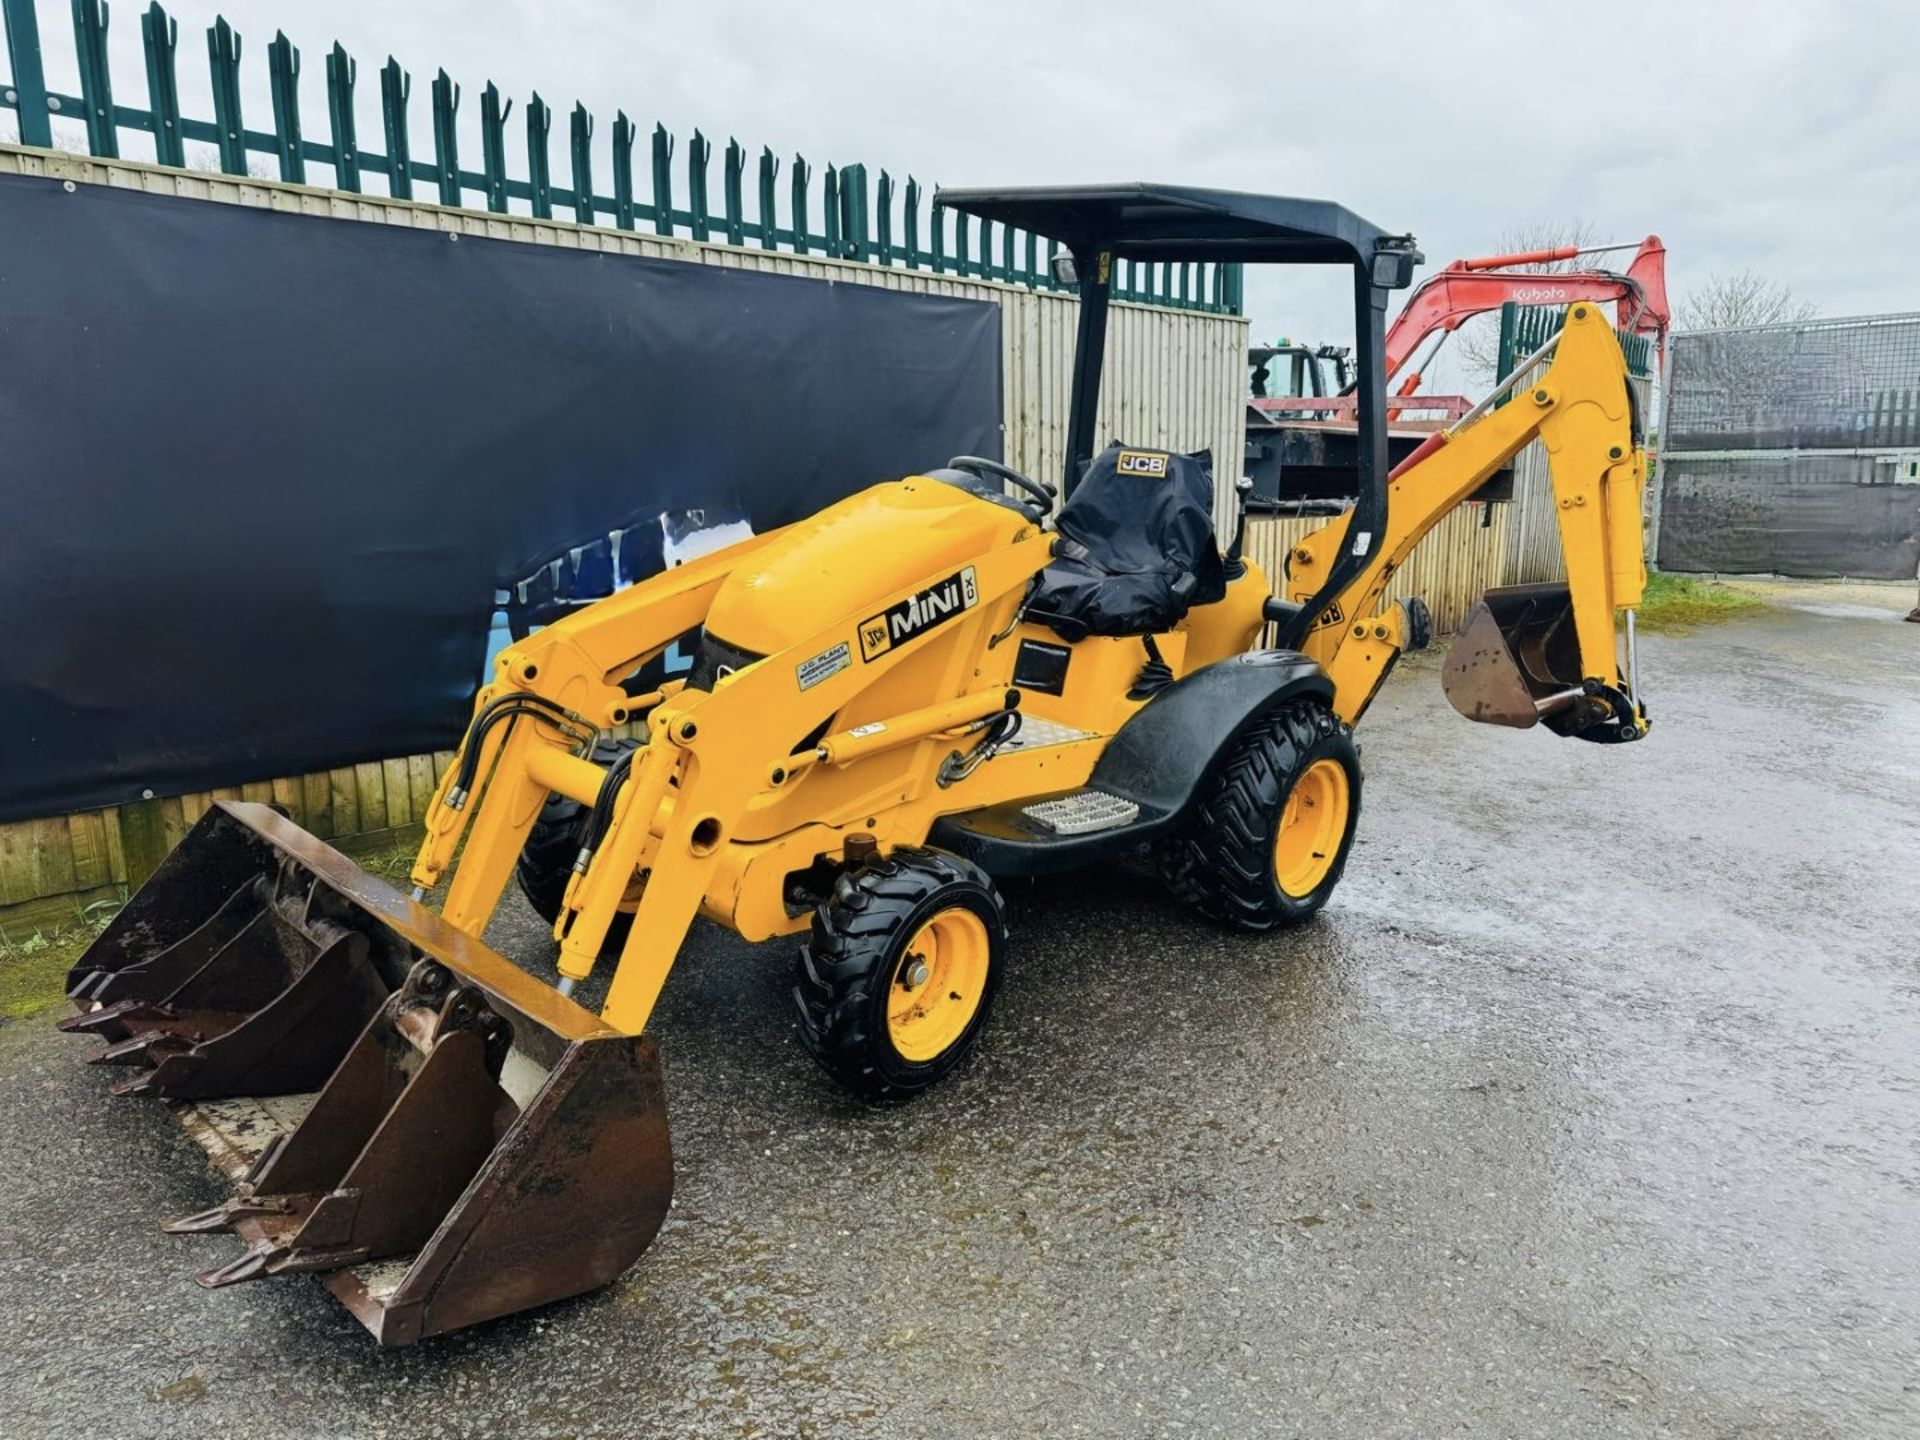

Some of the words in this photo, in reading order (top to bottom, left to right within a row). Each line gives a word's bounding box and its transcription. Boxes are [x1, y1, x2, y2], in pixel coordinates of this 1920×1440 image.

[1512, 286, 1566, 301] Kubota
[1122, 456, 1164, 472] JCB
[866, 627, 887, 648] JCB
[891, 583, 960, 640] MINI
[966, 577, 975, 600] CX
[818, 645, 844, 662] PLANT
